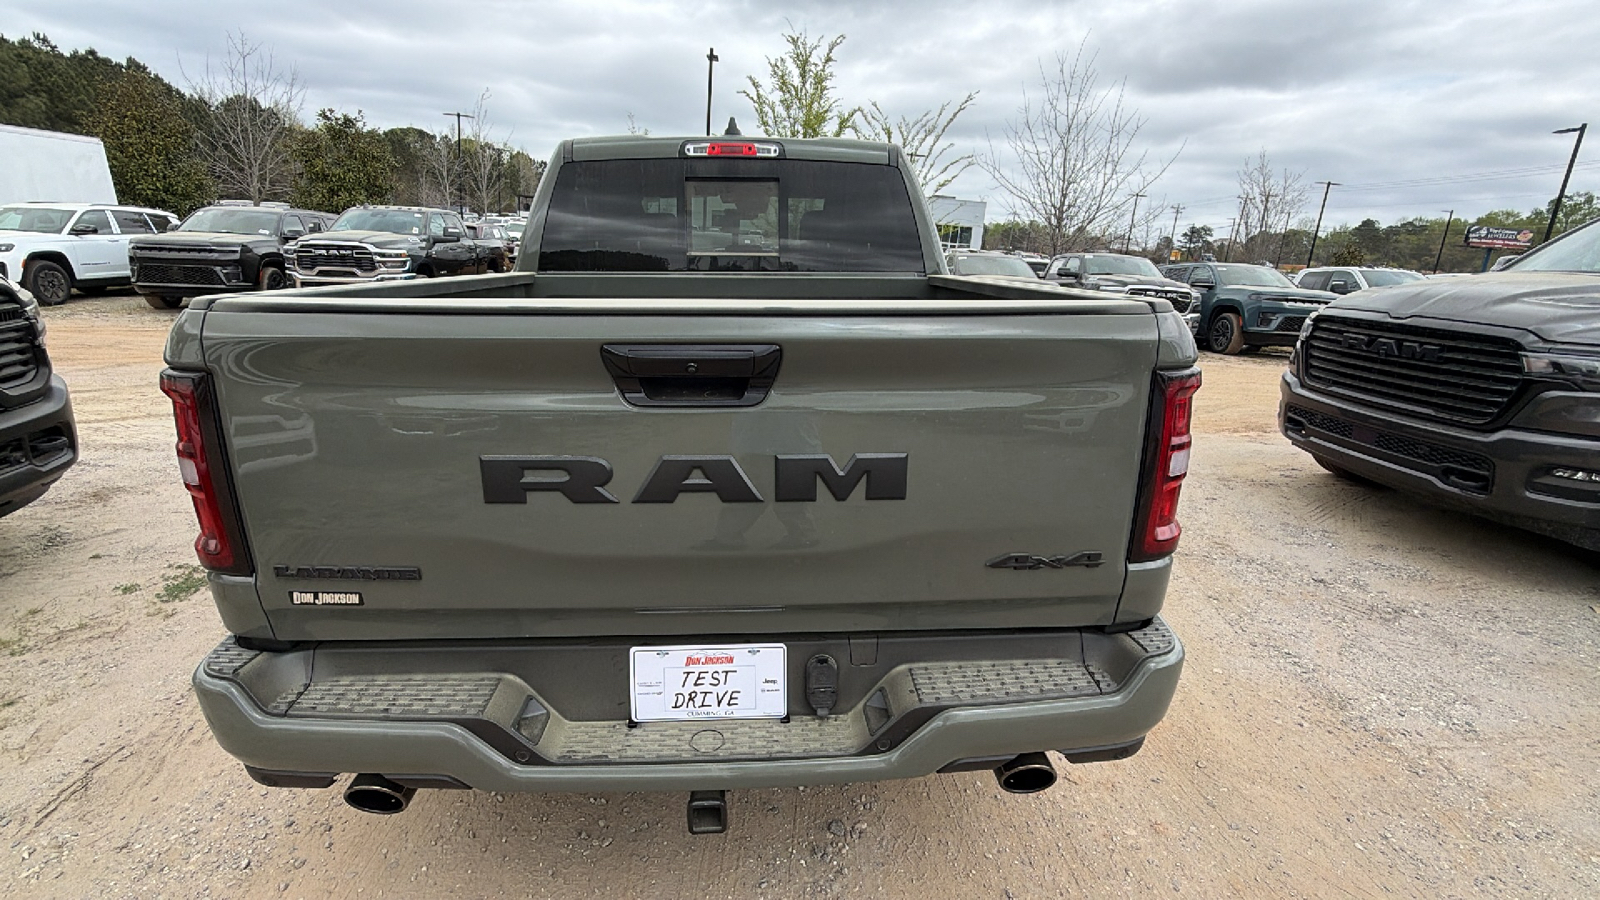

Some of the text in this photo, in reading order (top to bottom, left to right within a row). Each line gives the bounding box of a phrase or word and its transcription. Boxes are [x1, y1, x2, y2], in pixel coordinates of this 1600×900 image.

[314, 249, 353, 257] RAM
[1340, 332, 1443, 363] RAM
[479, 453, 908, 504] RAM
[273, 564, 422, 581] LARAMIE
[681, 670, 738, 688] TEST
[762, 677, 778, 685] Jeep
[671, 690, 742, 709] DRIVE
